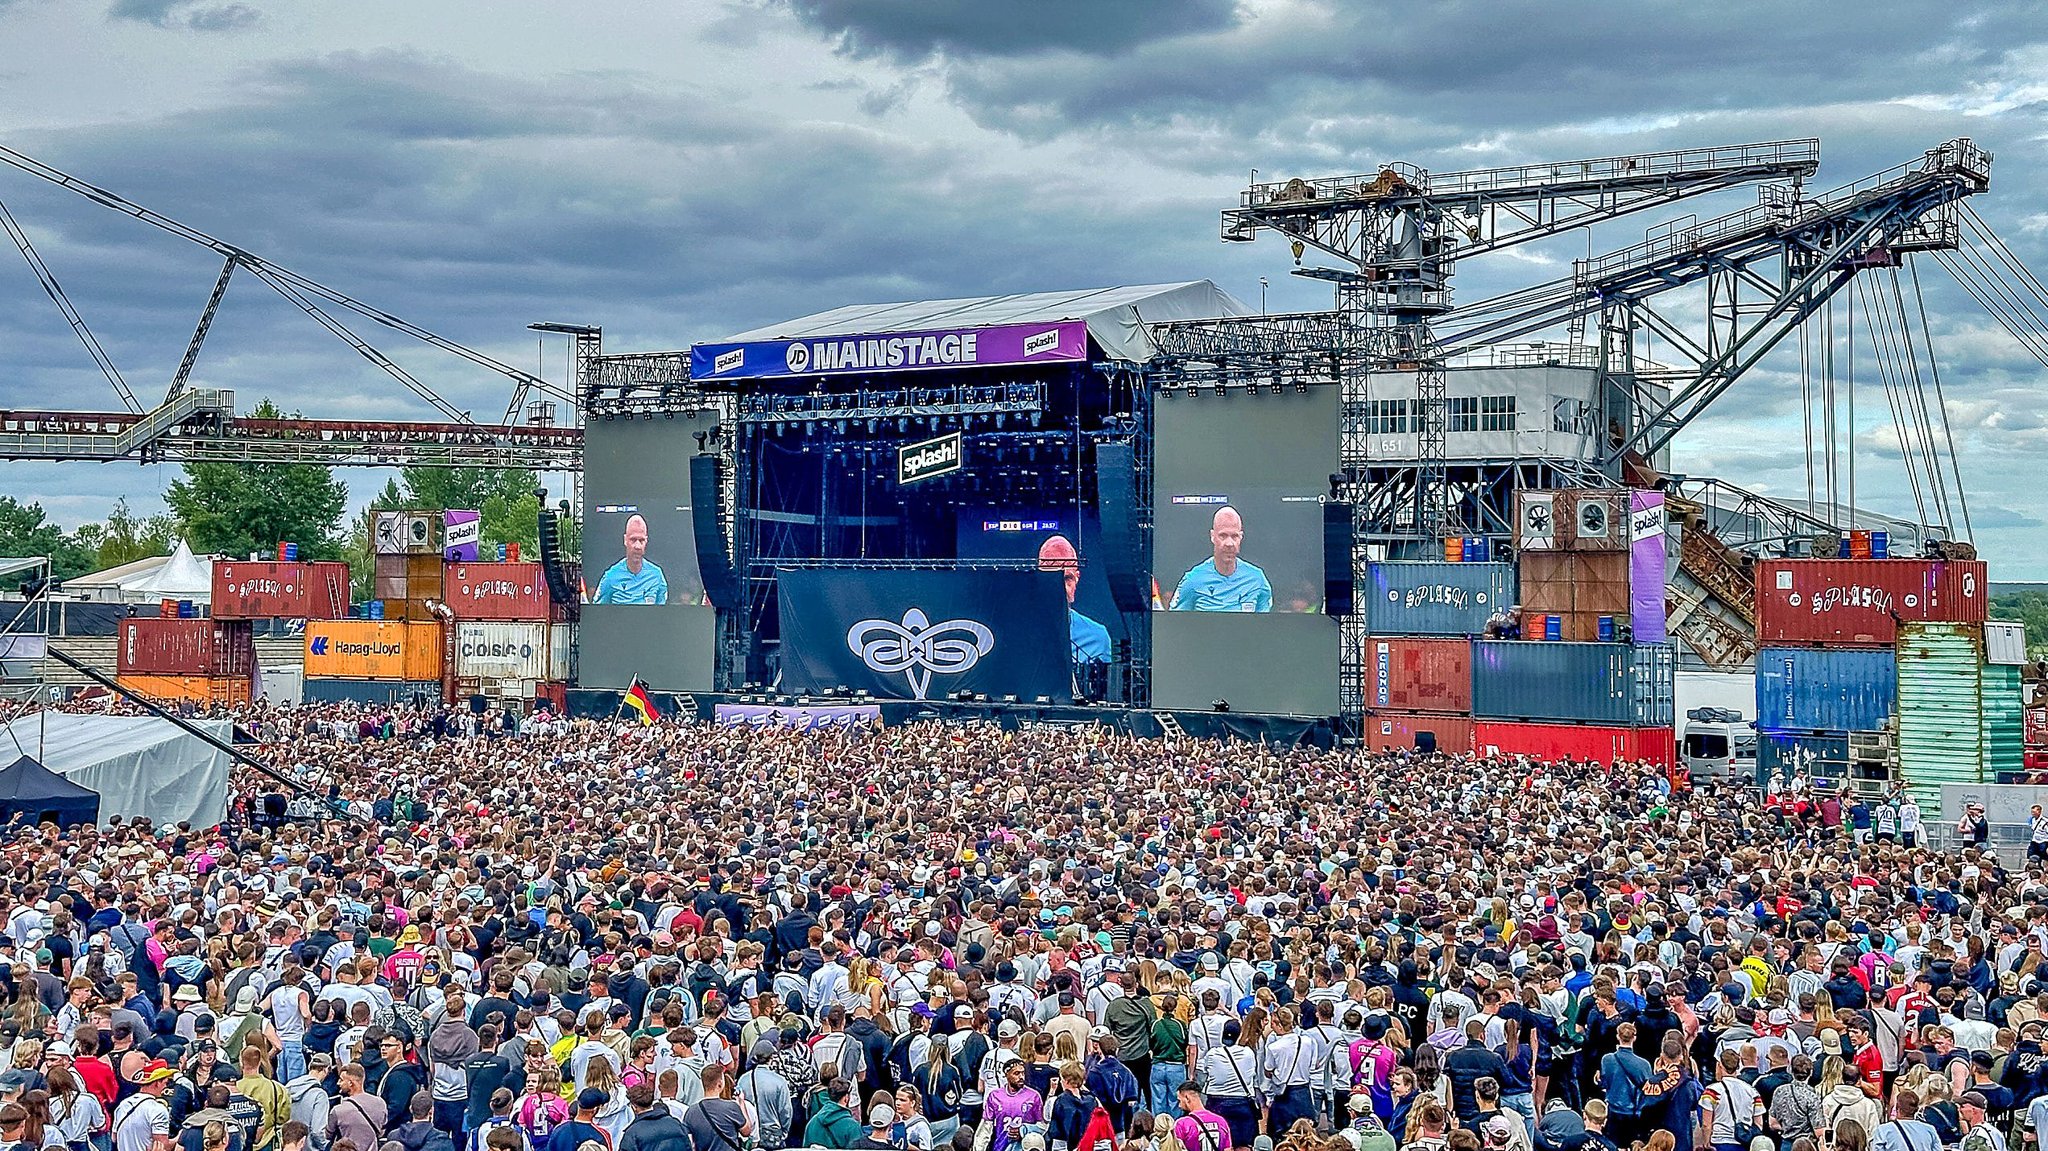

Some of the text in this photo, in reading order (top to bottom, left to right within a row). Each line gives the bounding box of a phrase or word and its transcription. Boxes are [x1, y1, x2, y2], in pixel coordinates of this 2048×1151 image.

[789, 334, 977, 370] JD MAINSTAGE
[1026, 333, 1056, 352] splash!
[717, 352, 742, 369] splash!
[1381, 440, 1402, 452] 651
[903, 440, 957, 475] splash!
[1634, 510, 1662, 535] splash!
[448, 524, 476, 543] splash!
[334, 640, 401, 657] Hapag-Lloyd
[461, 643, 532, 658] COSCO
[1378, 653, 1389, 705] CRONOS
[1360, 1056, 1376, 1086] 9
